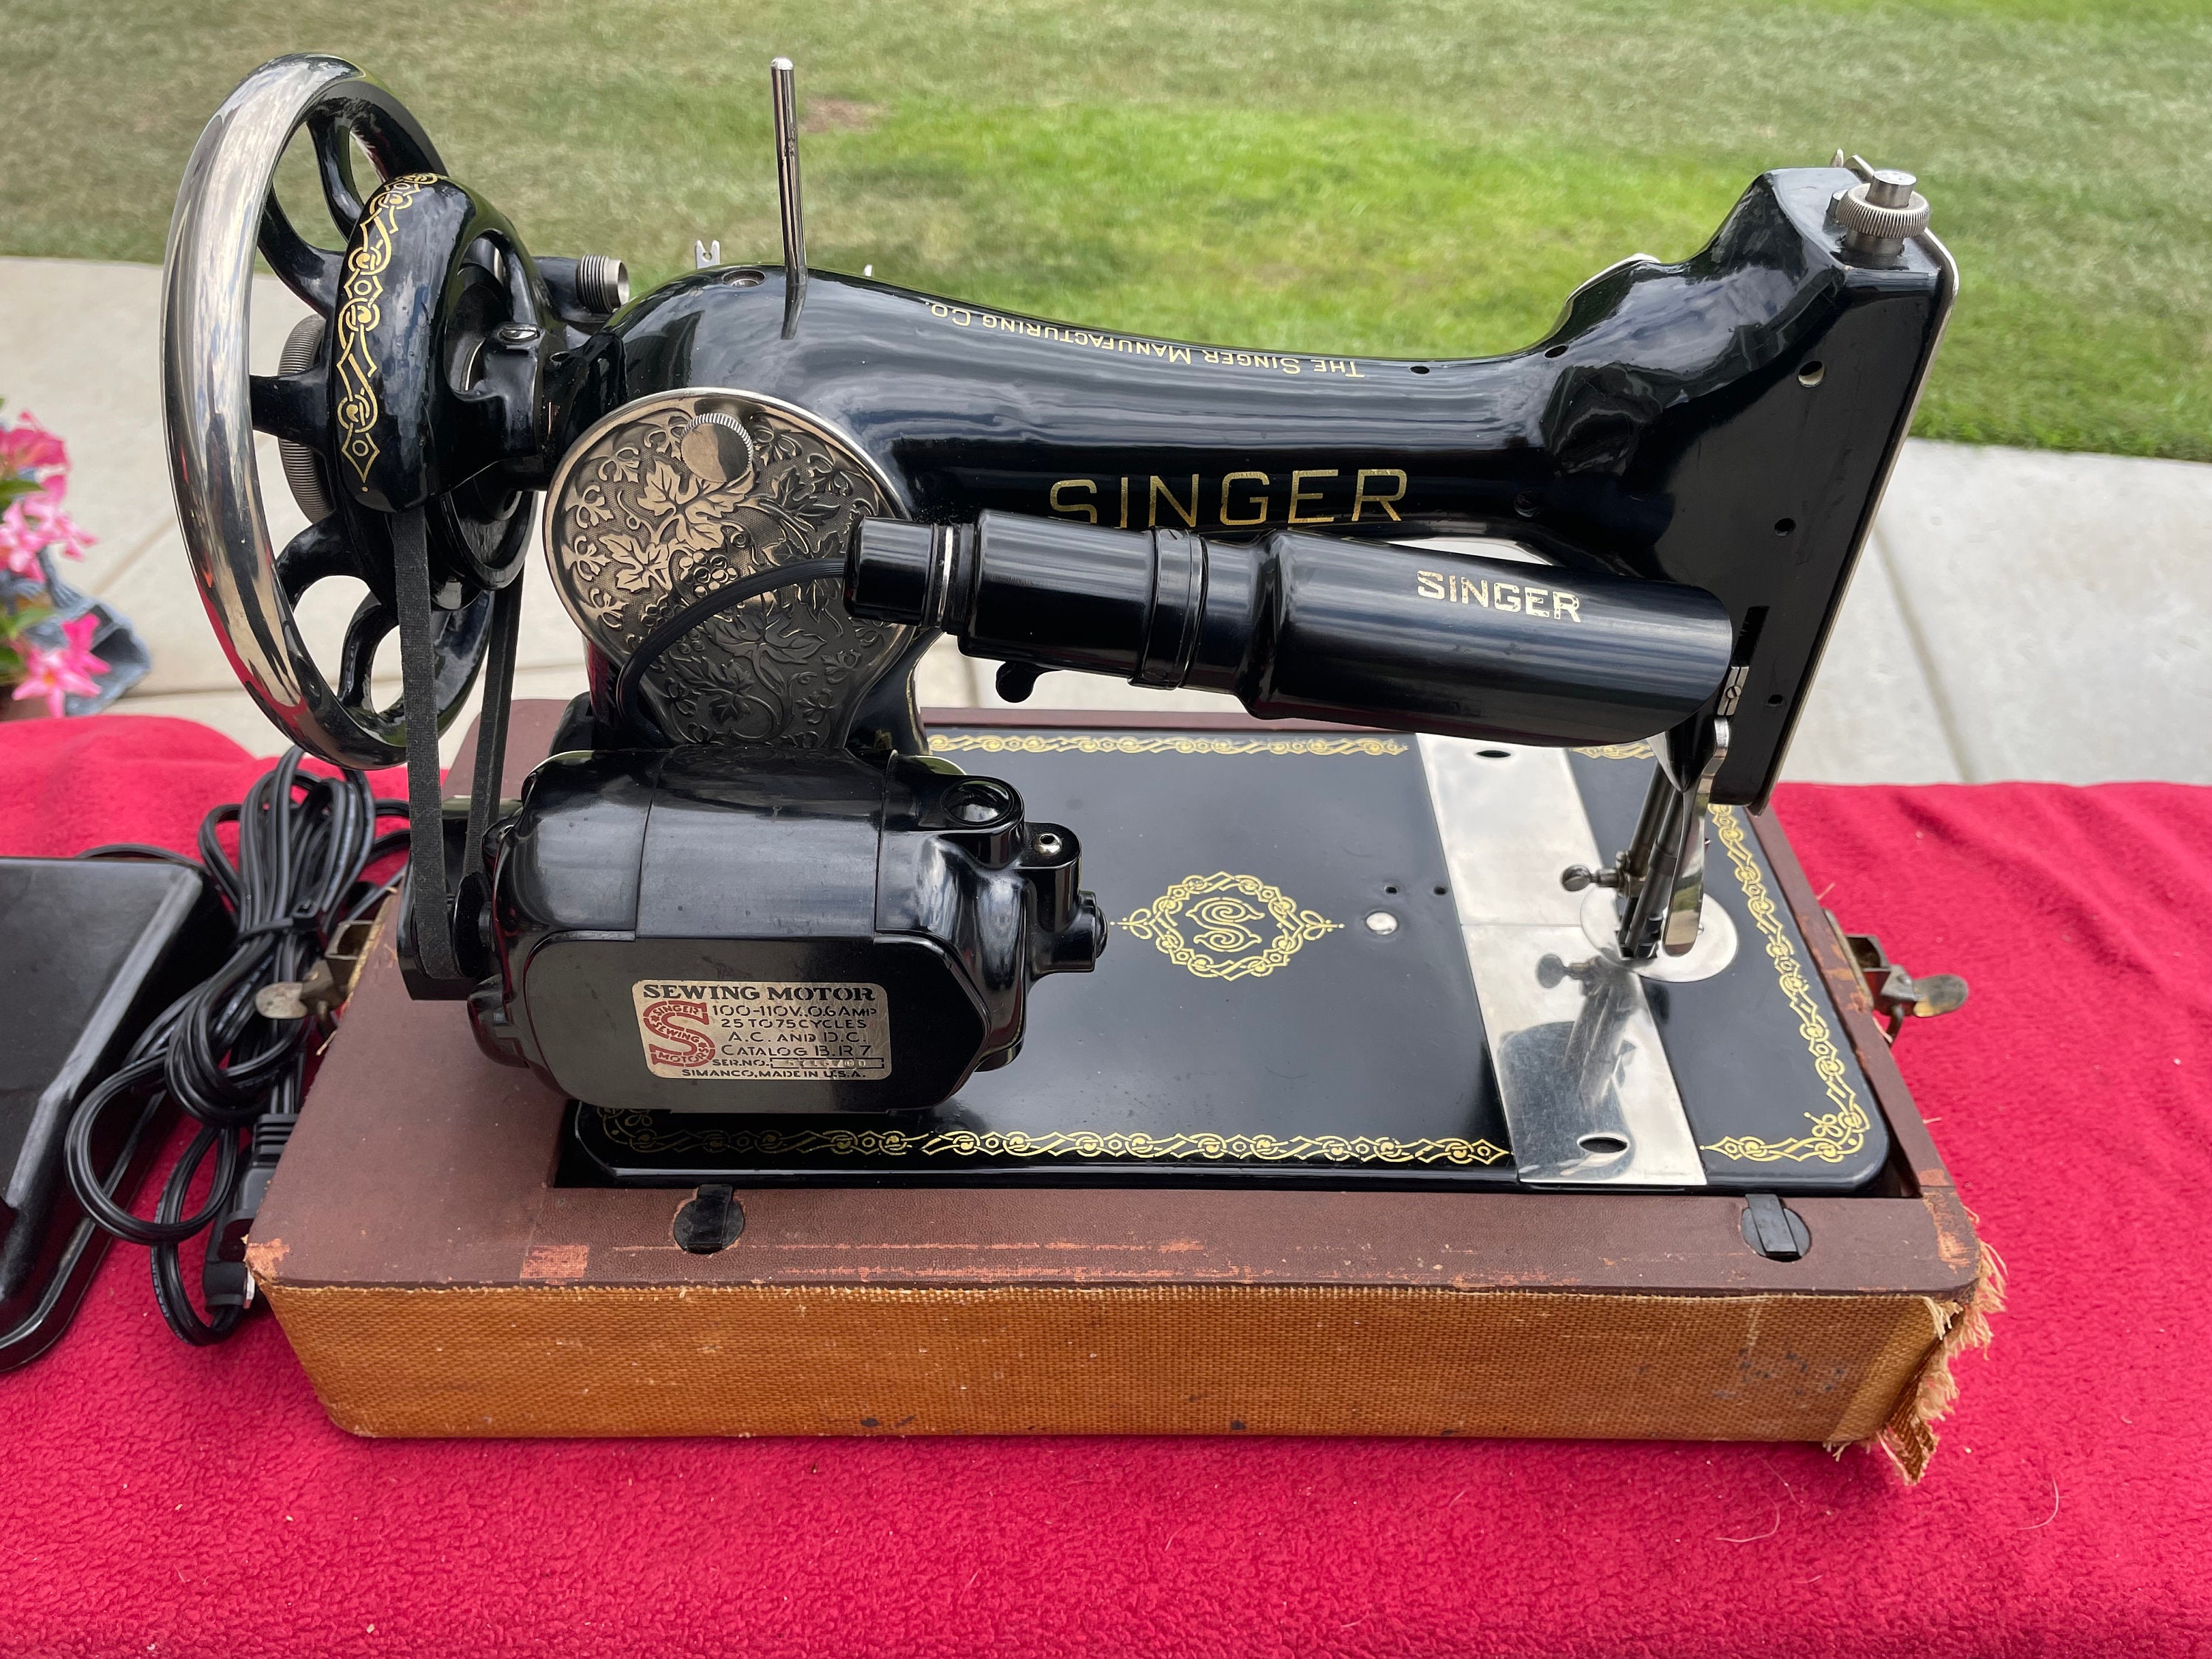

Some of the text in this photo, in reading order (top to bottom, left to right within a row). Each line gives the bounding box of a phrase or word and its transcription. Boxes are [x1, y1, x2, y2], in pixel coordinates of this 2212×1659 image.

[925, 302, 1365, 378] THE SINGER MANUFACTURING CO.
[1049, 469, 1408, 529] SINGER
[1416, 570, 1582, 623] SINGER
[643, 984, 876, 1001] SEWING MOTOR
[653, 1005, 699, 1017] SINGER
[720, 1018, 744, 1029] 25
[748, 1019, 773, 1029] TO
[652, 1022, 700, 1043] SEWING
[776, 1033, 817, 1043] AND
[658, 1046, 709, 1063] MOTORS
[721, 1044, 808, 1057] CATALOG
